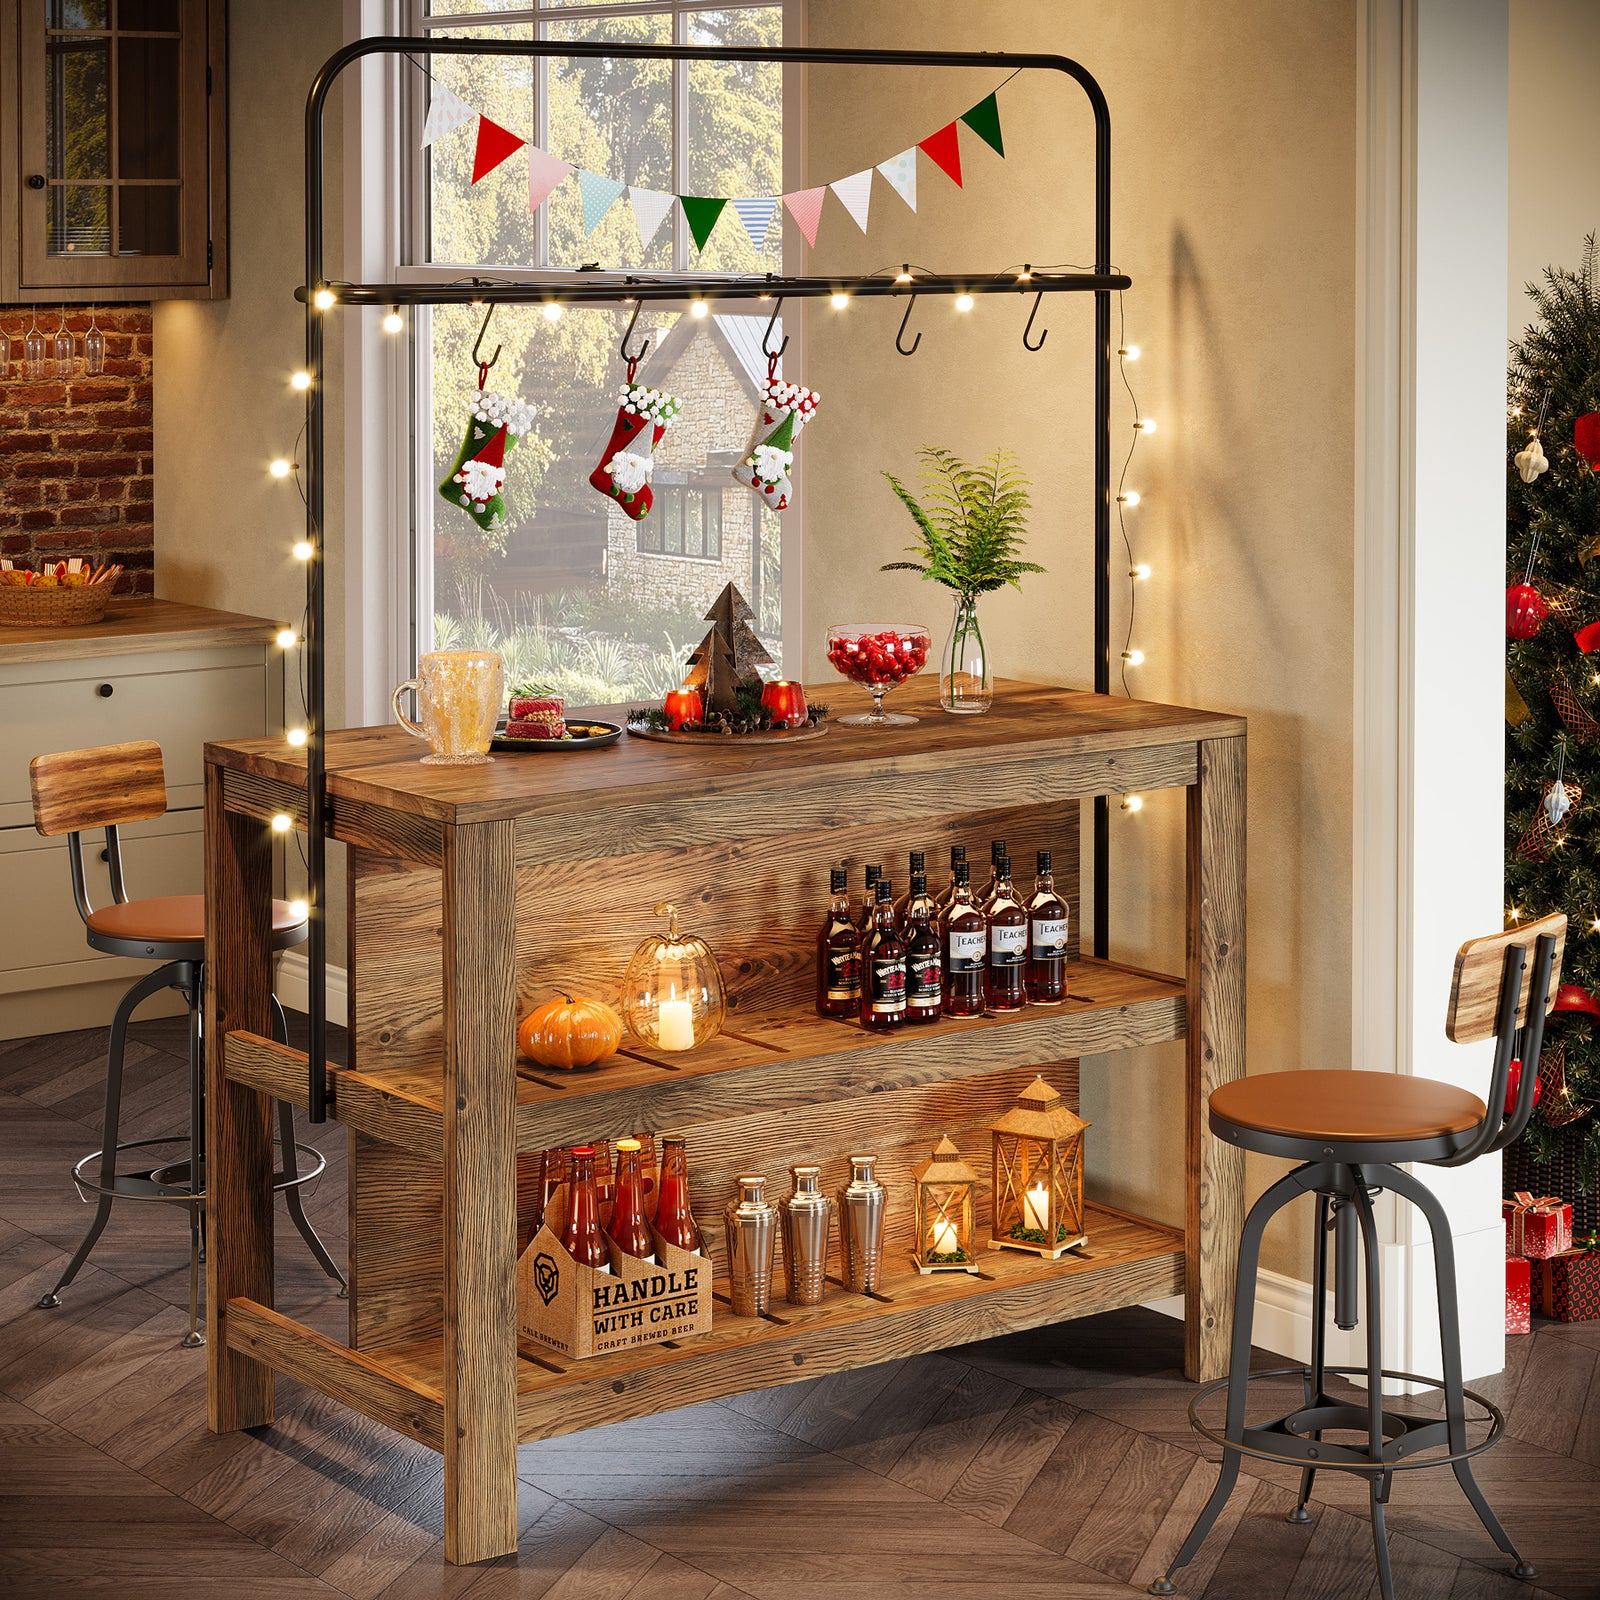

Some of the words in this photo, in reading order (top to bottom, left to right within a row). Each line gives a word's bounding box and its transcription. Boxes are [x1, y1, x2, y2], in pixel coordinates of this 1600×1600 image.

[593, 1268, 698, 1309] HANDLE
[594, 1311, 643, 1335] WITH
[650, 1299, 698, 1323] CARE
[540, 1333, 569, 1352] BREWERY
[597, 1338, 627, 1351] CRAFT
[631, 1329, 668, 1344] BREWED
[671, 1323, 694, 1335] BEER
